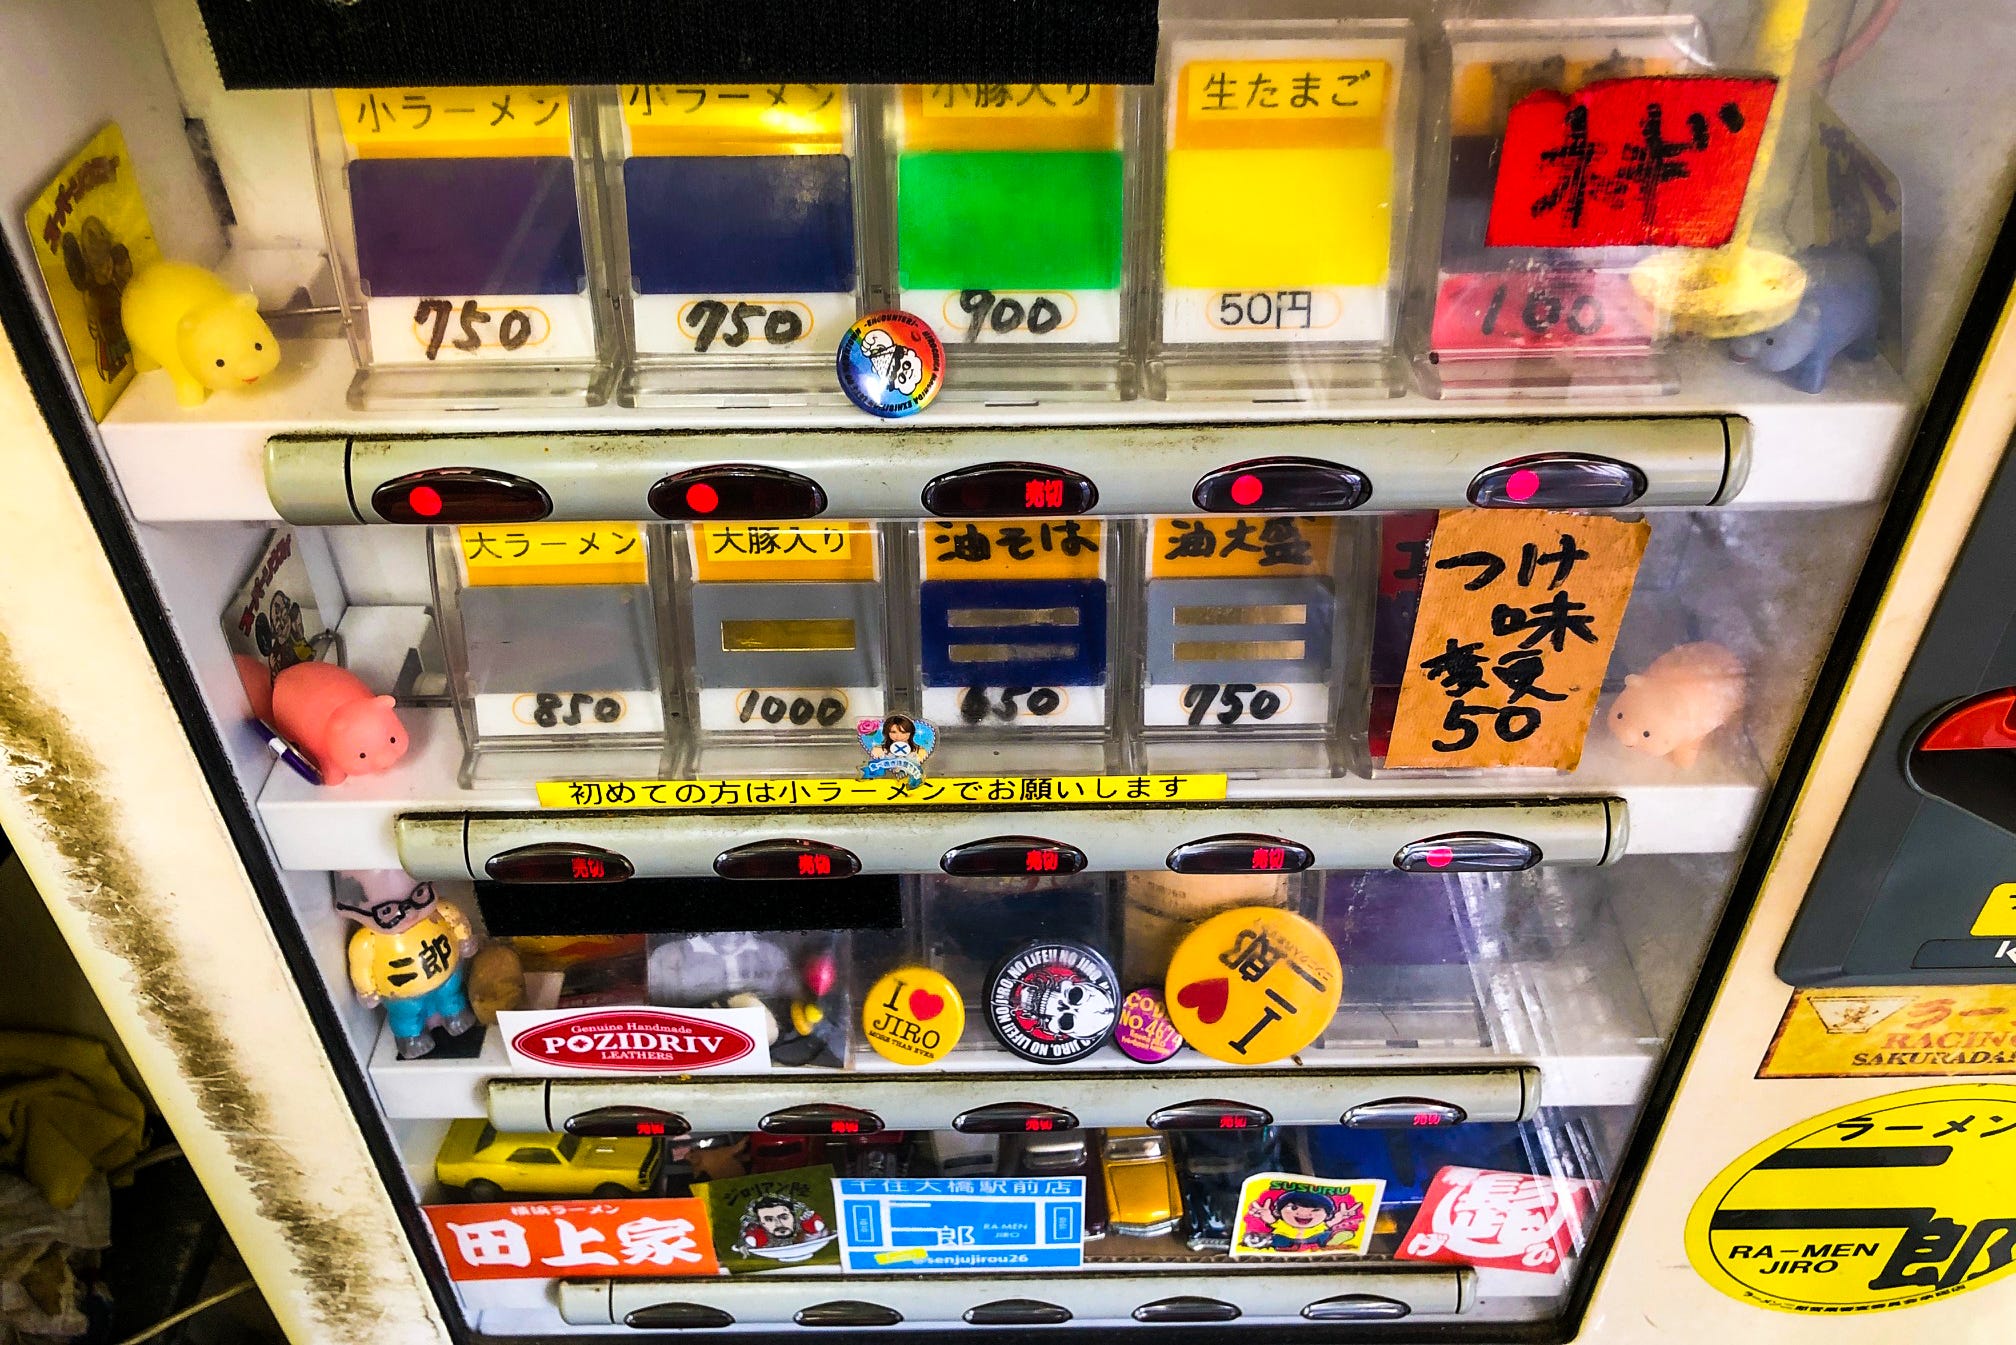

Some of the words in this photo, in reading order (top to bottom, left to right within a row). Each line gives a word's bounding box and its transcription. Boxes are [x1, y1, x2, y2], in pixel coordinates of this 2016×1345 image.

[1200, 69, 1371, 111] 生たまご
[357, 94, 560, 132] 小ラーメン
[684, 299, 802, 352] 750
[958, 288, 1062, 343] 900
[1218, 291, 1312, 330] 50円
[414, 299, 532, 360] 750
[1025, 479, 1064, 508] 売切
[466, 531, 637, 560] 大ラーメン
[712, 526, 846, 556] 大豚入り
[1435, 533, 1590, 591] つけ
[1490, 590, 1599, 653] 味
[533, 692, 622, 728] 850
[738, 690, 847, 727] 1000
[1183, 684, 1282, 727] 750
[1431, 700, 1542, 753] 50
[570, 776, 1189, 804] 初めての方は小ラーメンでお願いします
[387, 934, 452, 987] 二郎
[883, 980, 907, 1012] I
[1905, 998, 2016, 1030] ラー
[542, 1032, 724, 1054] POZIDRIV
[571, 1024, 623, 1034] Genuine
[626, 1023, 693, 1034] Handmade
[872, 1012, 940, 1049] JIRO
[601, 1051, 674, 1061] LEATHERS
[1836, 1115, 2016, 1142] ラーメン
[851, 1180, 1072, 1195] 千住大橋駅前店
[1269, 1180, 1351, 1196] SUSURU
[447, 1216, 703, 1269] 田上家
[1728, 1242, 1880, 1259] RA-MEN
[1759, 1260, 1840, 1275] JIRO
